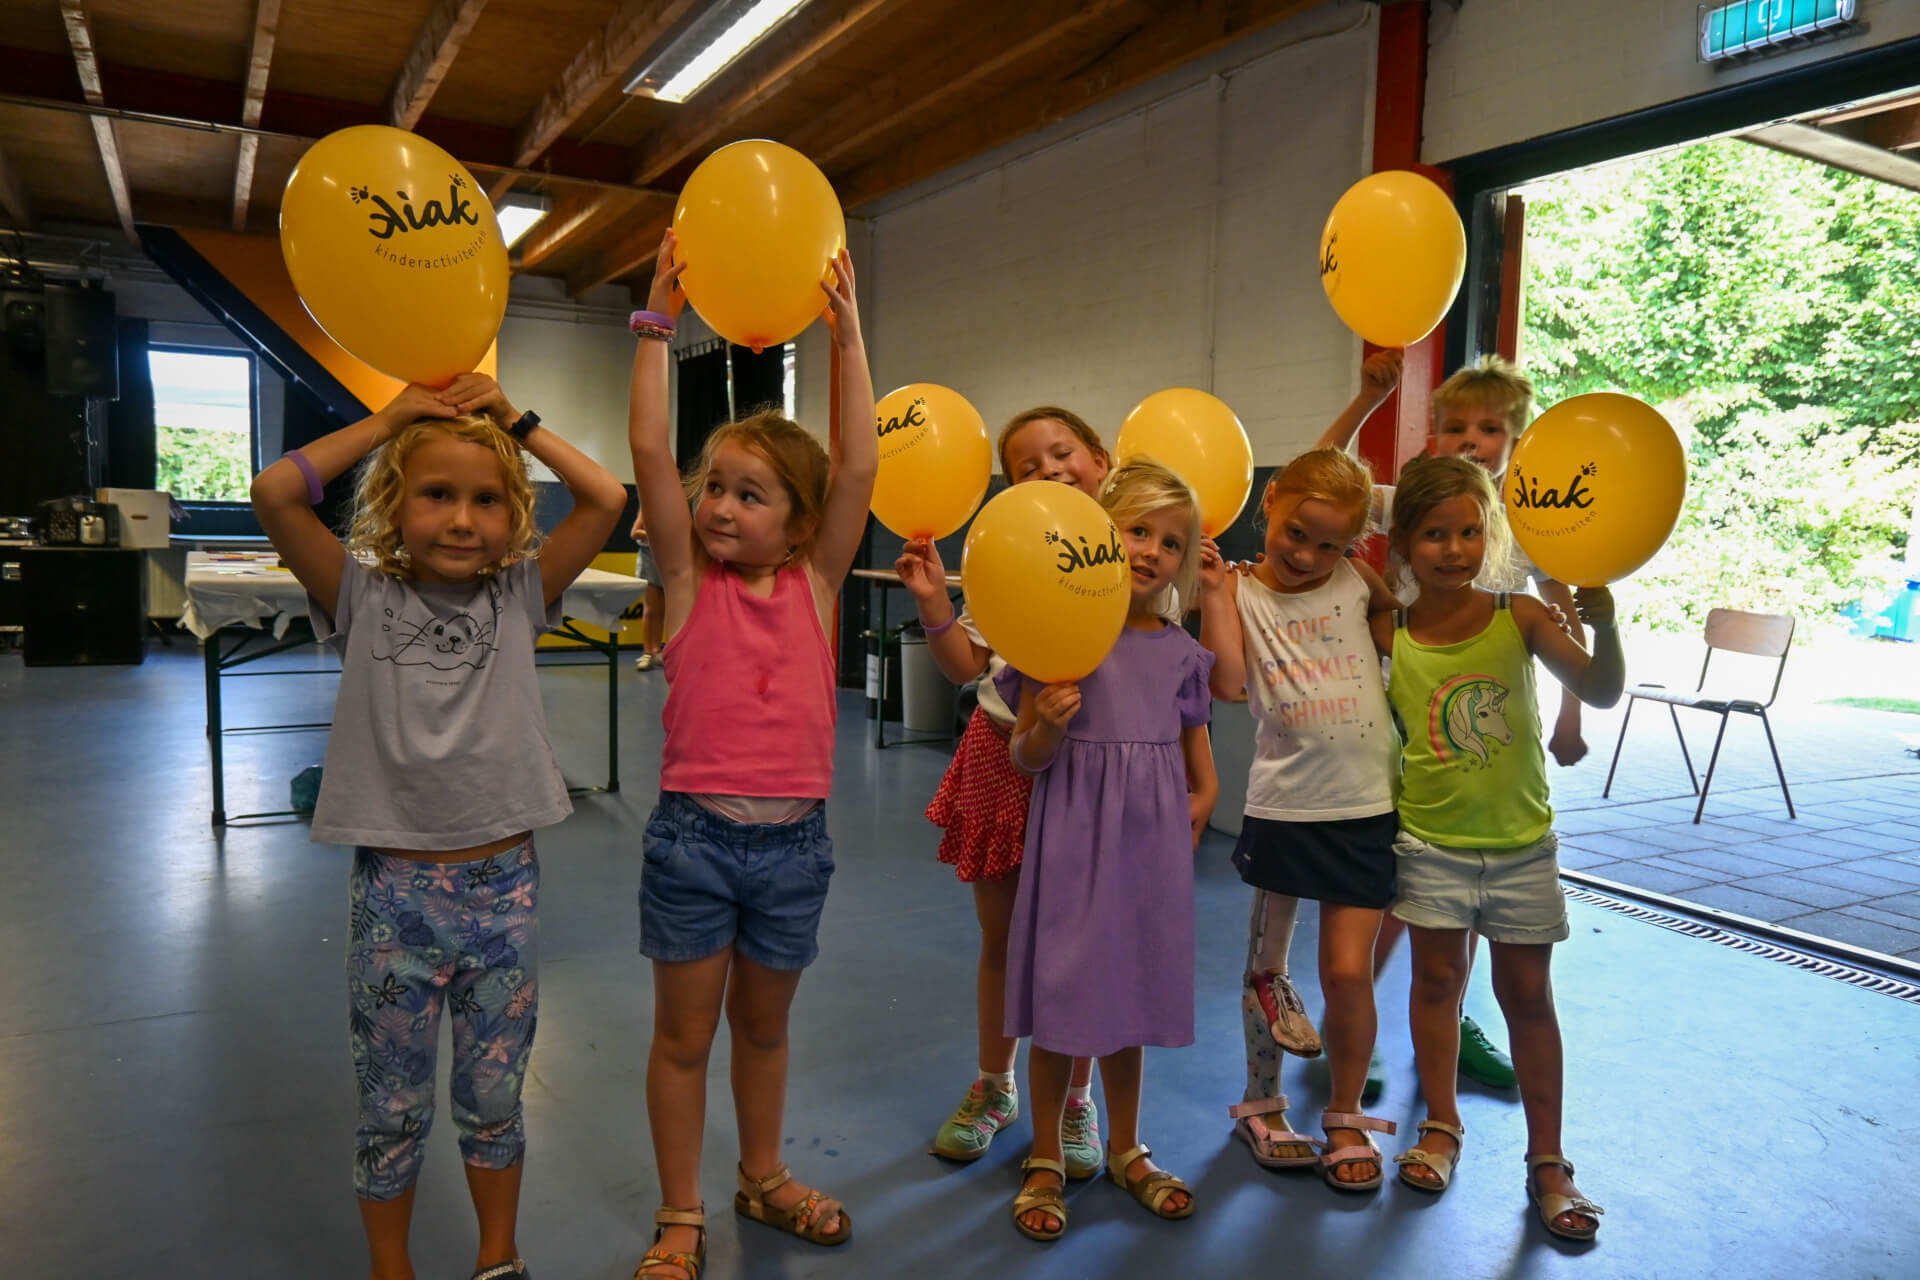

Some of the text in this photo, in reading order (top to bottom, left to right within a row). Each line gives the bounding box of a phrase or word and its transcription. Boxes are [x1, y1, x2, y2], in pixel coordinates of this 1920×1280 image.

[368, 185, 479, 239] kiak
[374, 229, 488, 270] kinderactiviteiten
[1513, 475, 1594, 509] kiak
[1057, 530, 1125, 573] kiak
[1280, 698, 1361, 728] SHINE!
